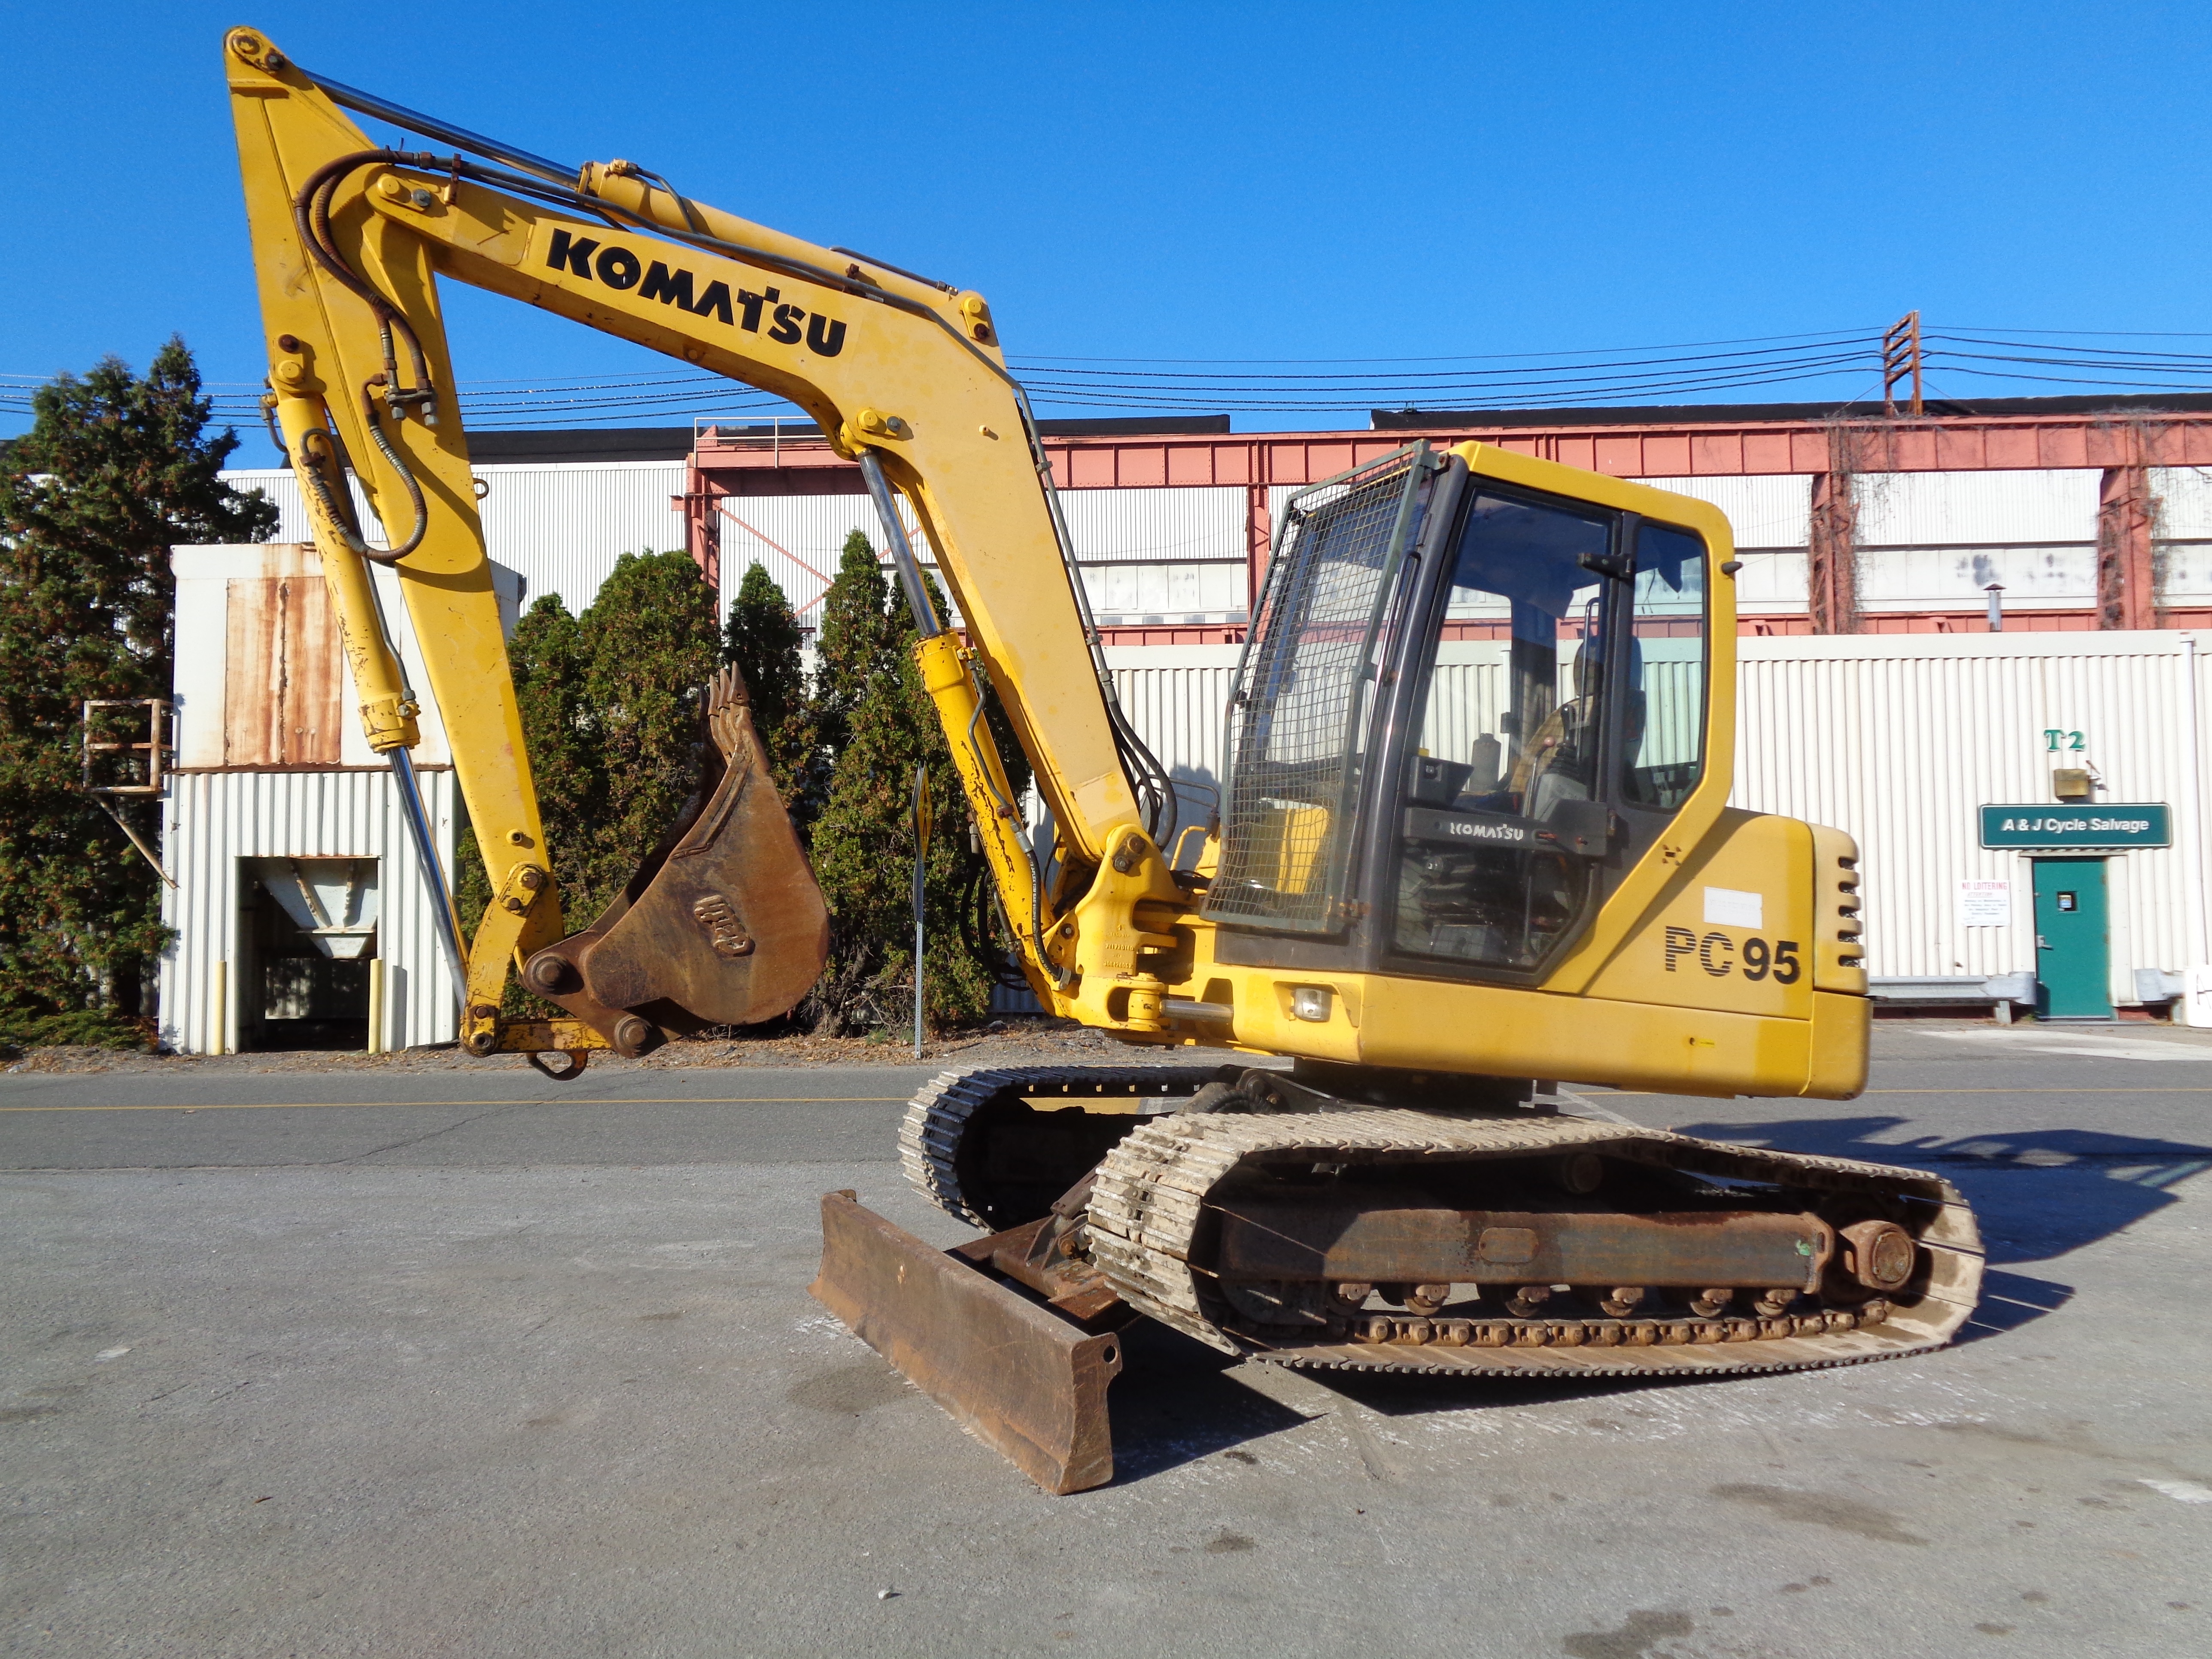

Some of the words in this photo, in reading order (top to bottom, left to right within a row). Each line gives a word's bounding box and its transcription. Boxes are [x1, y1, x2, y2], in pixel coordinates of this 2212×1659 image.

[546, 228, 847, 357] KOMATSU
[1450, 822, 1524, 841] KOMATSU
[2002, 819, 2015, 831] A
[2018, 819, 2030, 831] &
[2033, 819, 2043, 831] J
[2045, 818, 2087, 834] Cycle
[2090, 817, 2149, 833] Salvage
